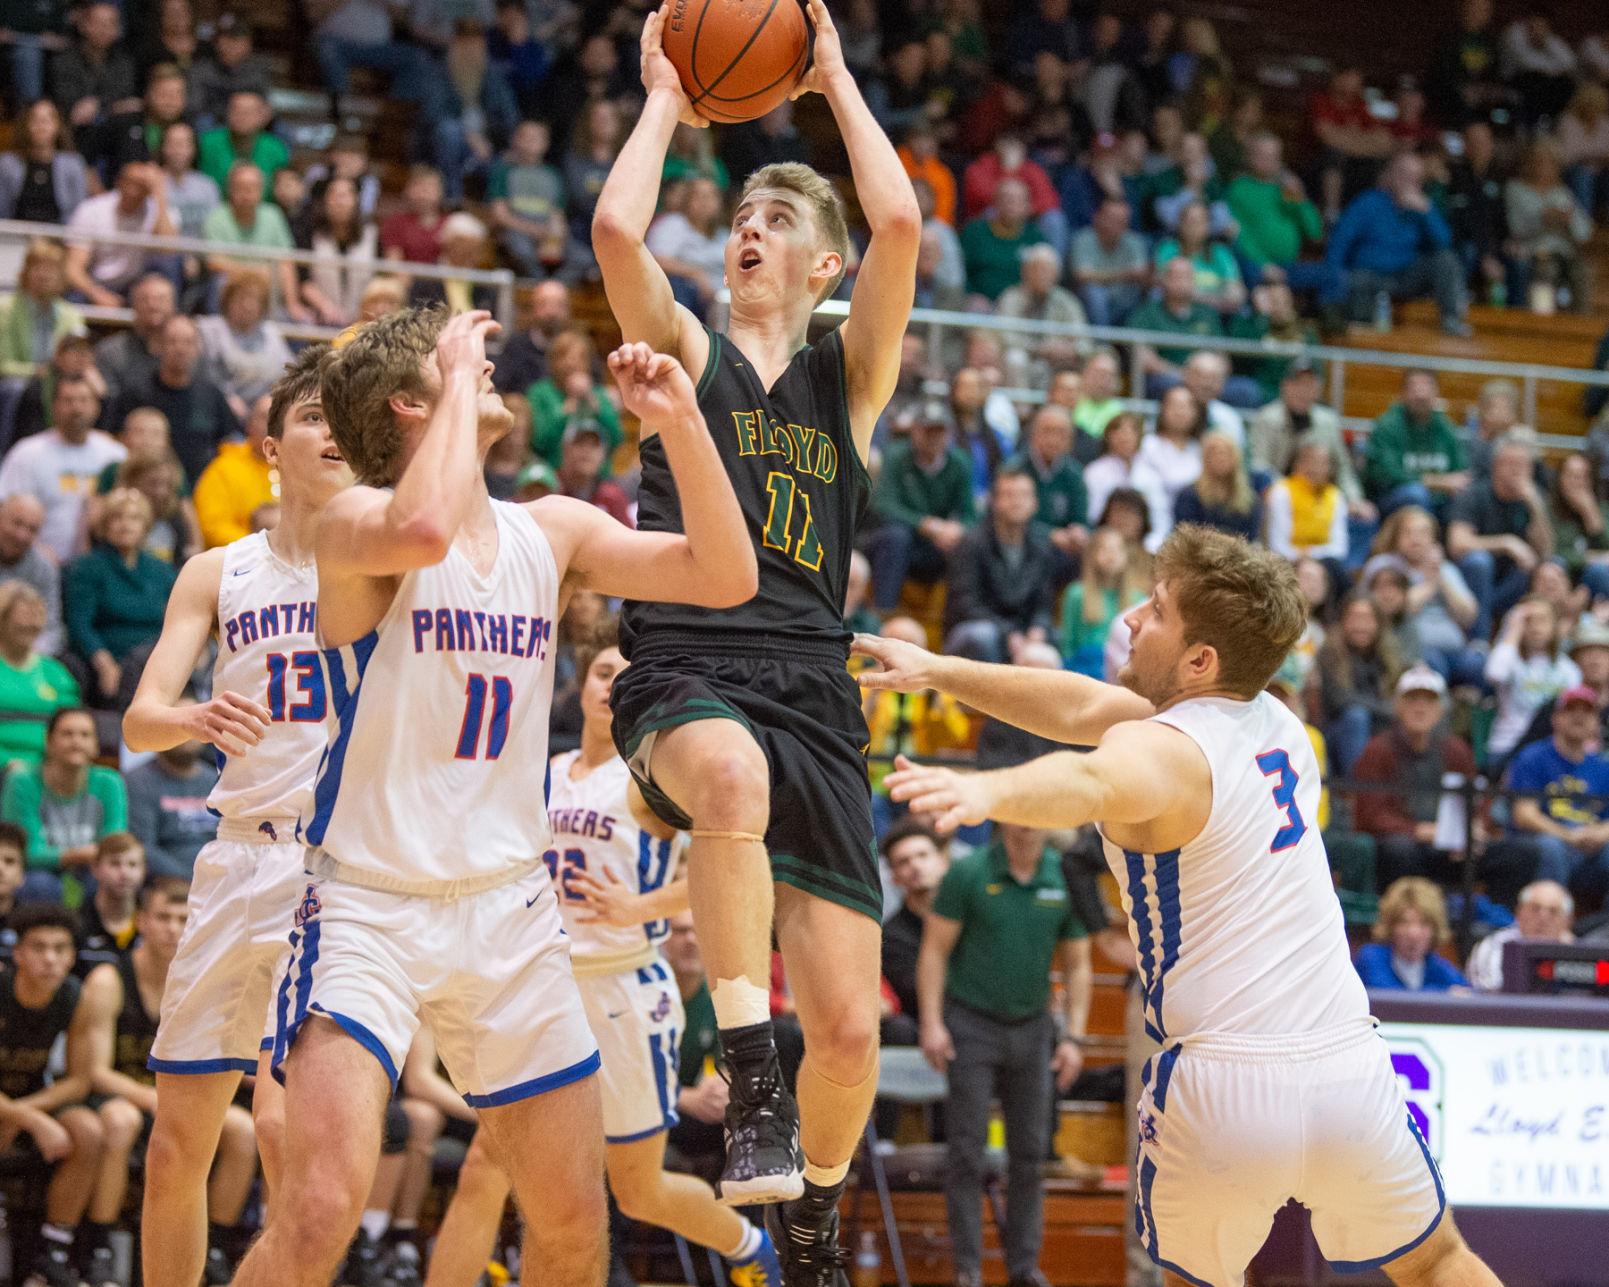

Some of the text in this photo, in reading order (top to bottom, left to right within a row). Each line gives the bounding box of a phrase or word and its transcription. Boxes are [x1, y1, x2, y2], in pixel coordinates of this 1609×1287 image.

[731, 409, 838, 484] FLOYD
[762, 471, 824, 572] 11
[224, 601, 317, 652] PANTH
[266, 650, 328, 723] 13
[454, 672, 514, 761] 11
[548, 808, 616, 842] THERS
[1255, 748, 1308, 854] 3
[1471, 1103, 1566, 1144] Lloyd
